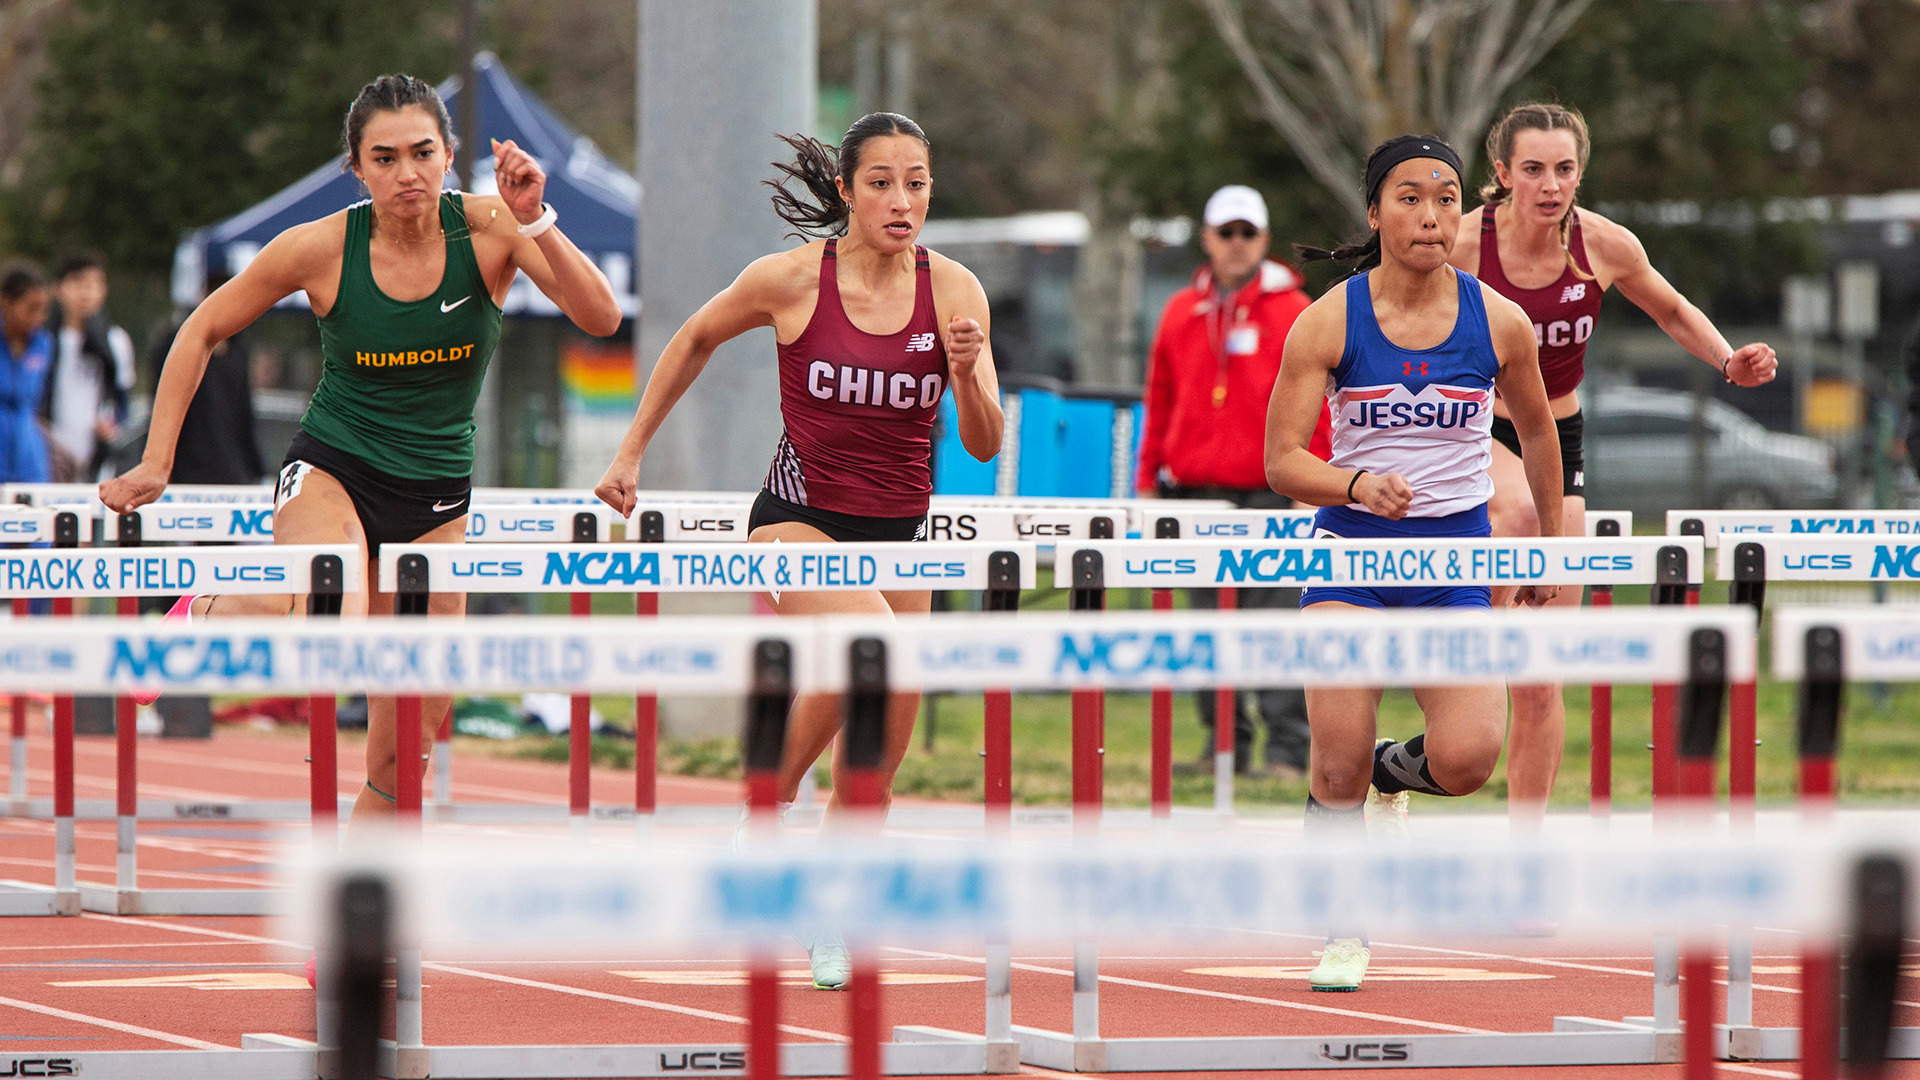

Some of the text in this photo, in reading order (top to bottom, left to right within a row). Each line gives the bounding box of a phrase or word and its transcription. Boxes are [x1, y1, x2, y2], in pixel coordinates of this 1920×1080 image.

[1534, 314, 1593, 347] ICO
[356, 344, 474, 367] HUMBOLDT
[808, 359, 942, 410] CHICO
[1350, 402, 1479, 428] JESSUP
[2, 520, 38, 533] CS
[158, 517, 213, 529] UCS
[500, 519, 554, 531] UCS
[680, 519, 734, 531] UCS
[1017, 524, 1070, 535] UCS
[1195, 524, 1249, 535] UCS
[93, 558, 110, 589] &
[120, 558, 196, 588] FIELD
[214, 566, 285, 581] UCS
[452, 552, 965, 585] UCS NCAA TRACK & FIELD UCS
[1126, 549, 1633, 582] UCS NCAA TRACK & FIELD UCS
[1784, 555, 1852, 569] UCS
[108, 637, 275, 682] NCAA
[1053, 632, 1217, 674] NCAA
[661, 1052, 746, 1070] UCS
[1324, 1043, 1408, 1061] UCS
